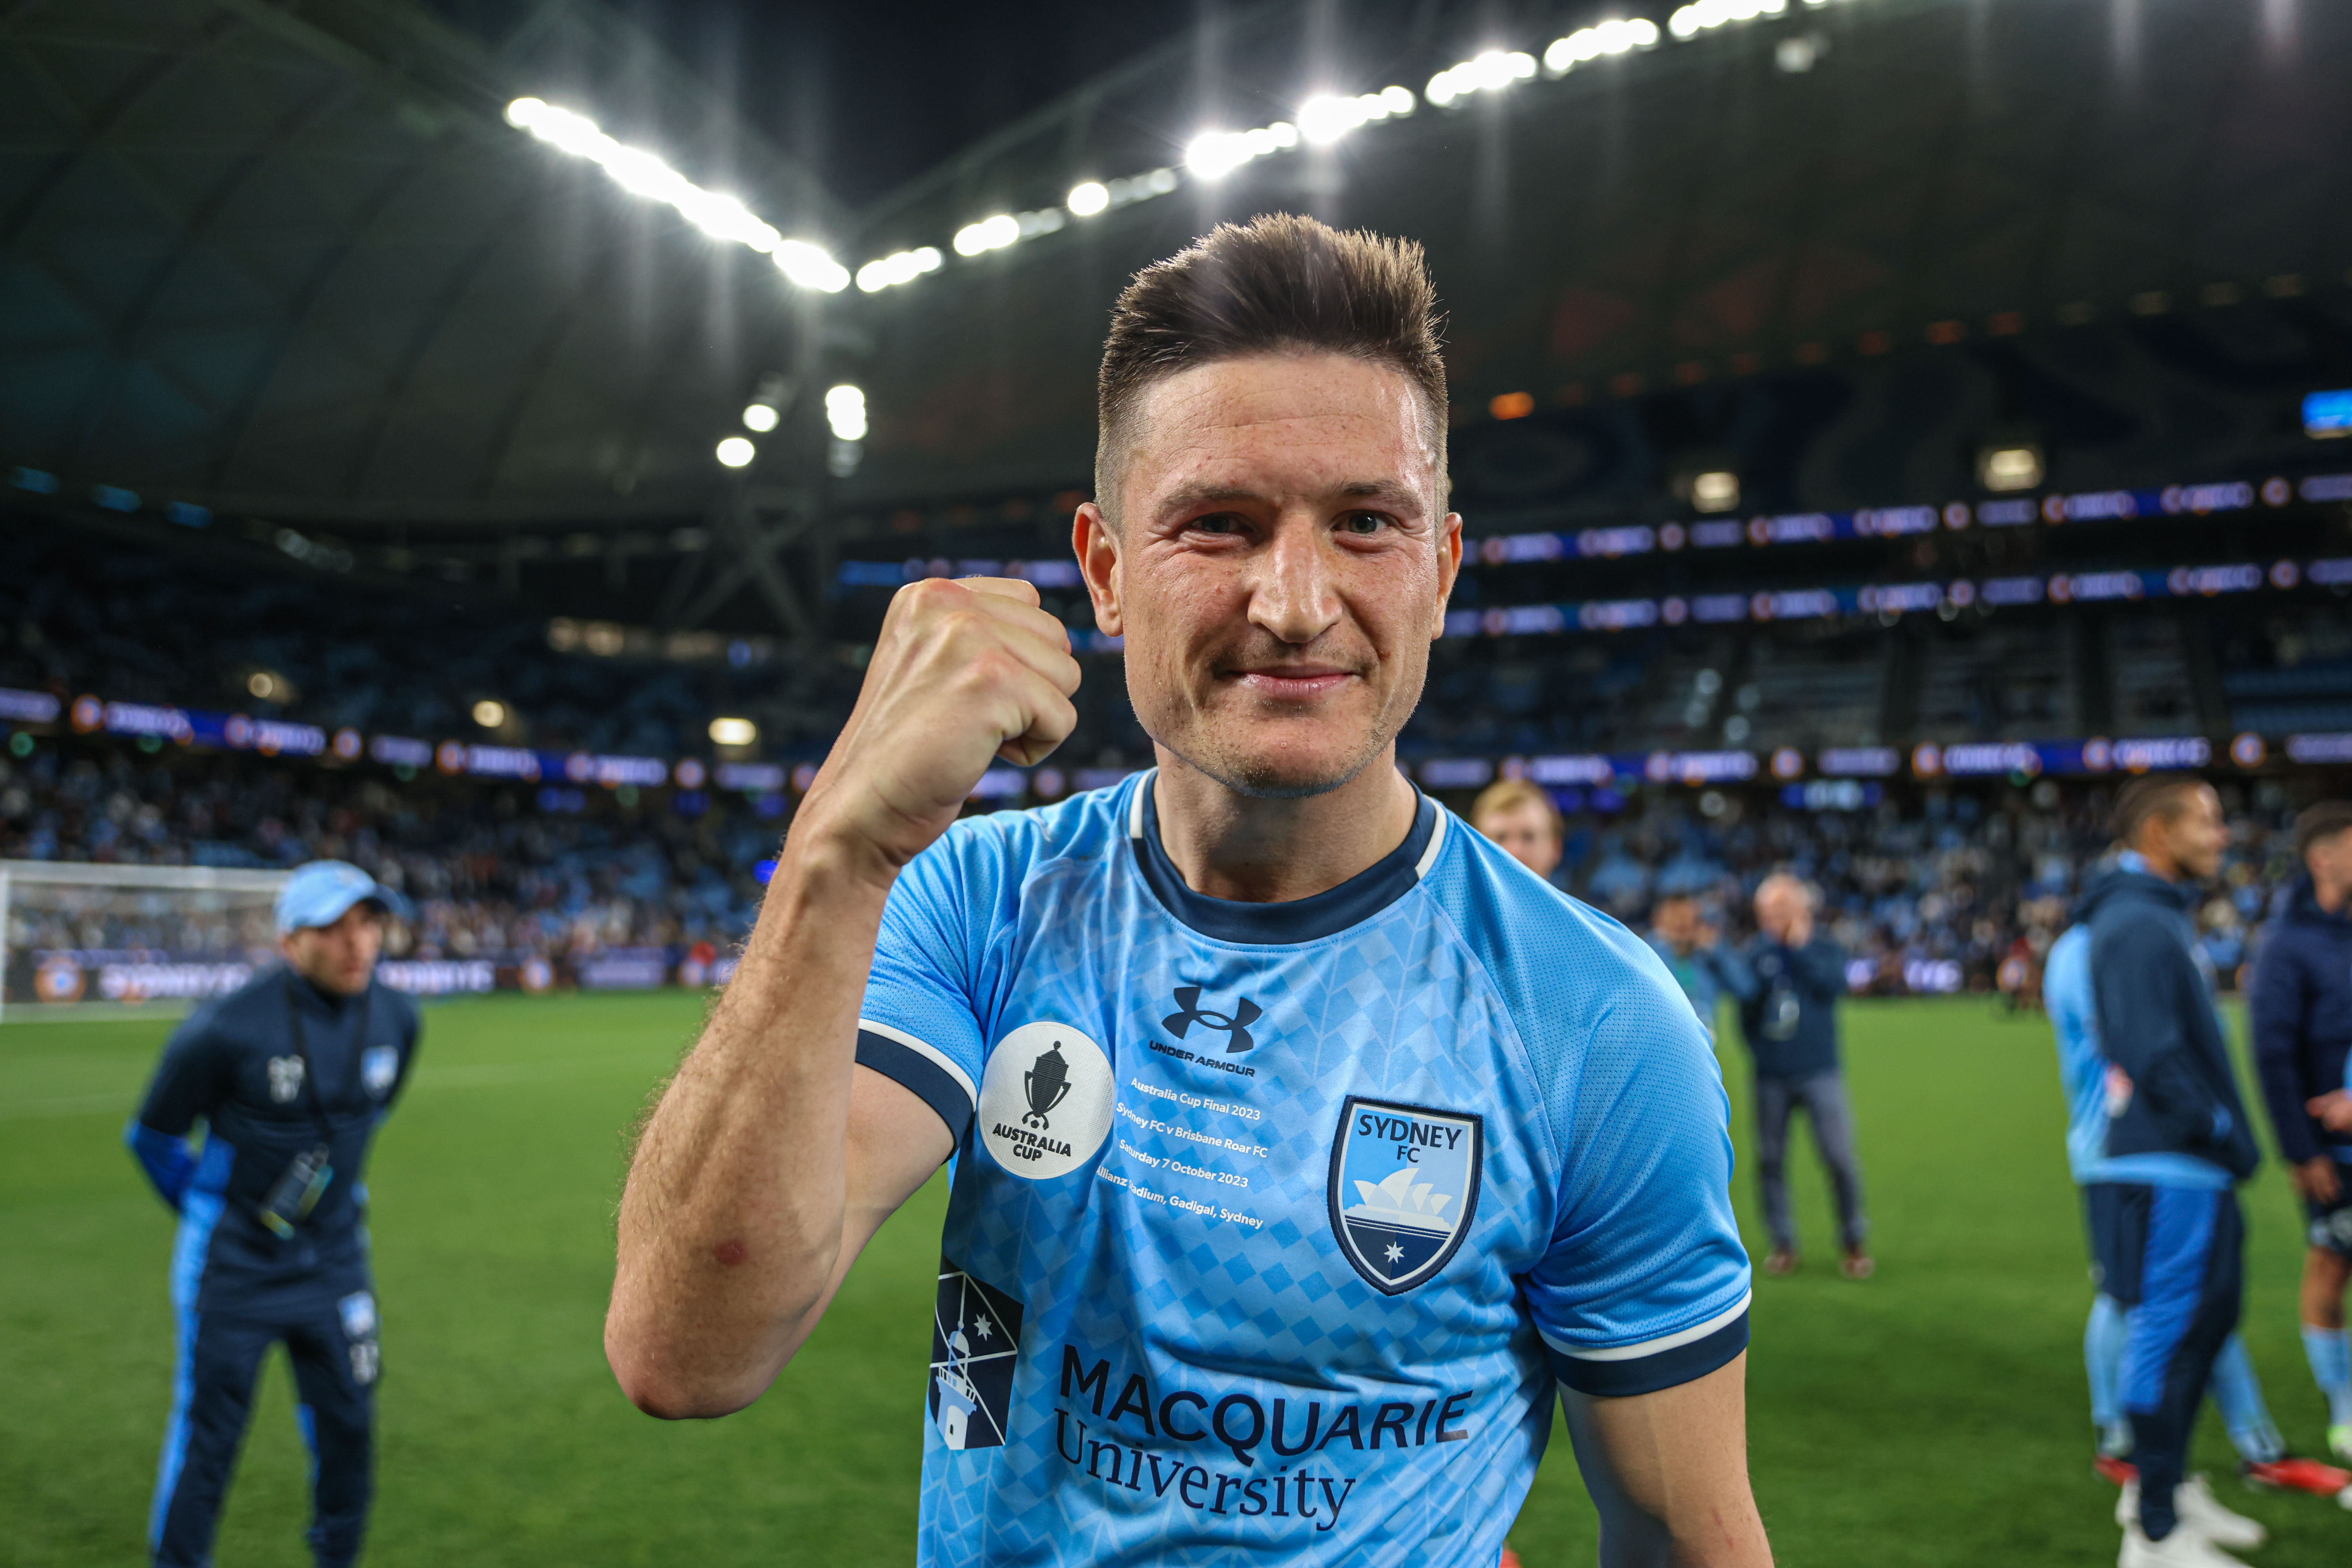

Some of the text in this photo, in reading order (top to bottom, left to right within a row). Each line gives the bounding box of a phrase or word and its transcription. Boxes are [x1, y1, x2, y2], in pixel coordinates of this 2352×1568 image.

[1149, 1040, 1255, 1078] UNDER ARMOUR
[1131, 1077, 1261, 1121] Australia Cup Final 2023
[992, 1123, 1071, 1157] AUSTRALIA
[1013, 1144, 1042, 1161] CUP
[1116, 1102, 1268, 1159] Sydney FC v Brisbane Roar FC
[1358, 1114, 1462, 1150] SYDNEY
[1119, 1139, 1248, 1188] Saturday 7 October 2023
[1397, 1144, 1420, 1163] FC
[1096, 1165, 1263, 1229] Allianz Stadium, Gadigal, Sydney
[1059, 1344, 1474, 1467] MACQUARIE
[1054, 1407, 1356, 1531] University
